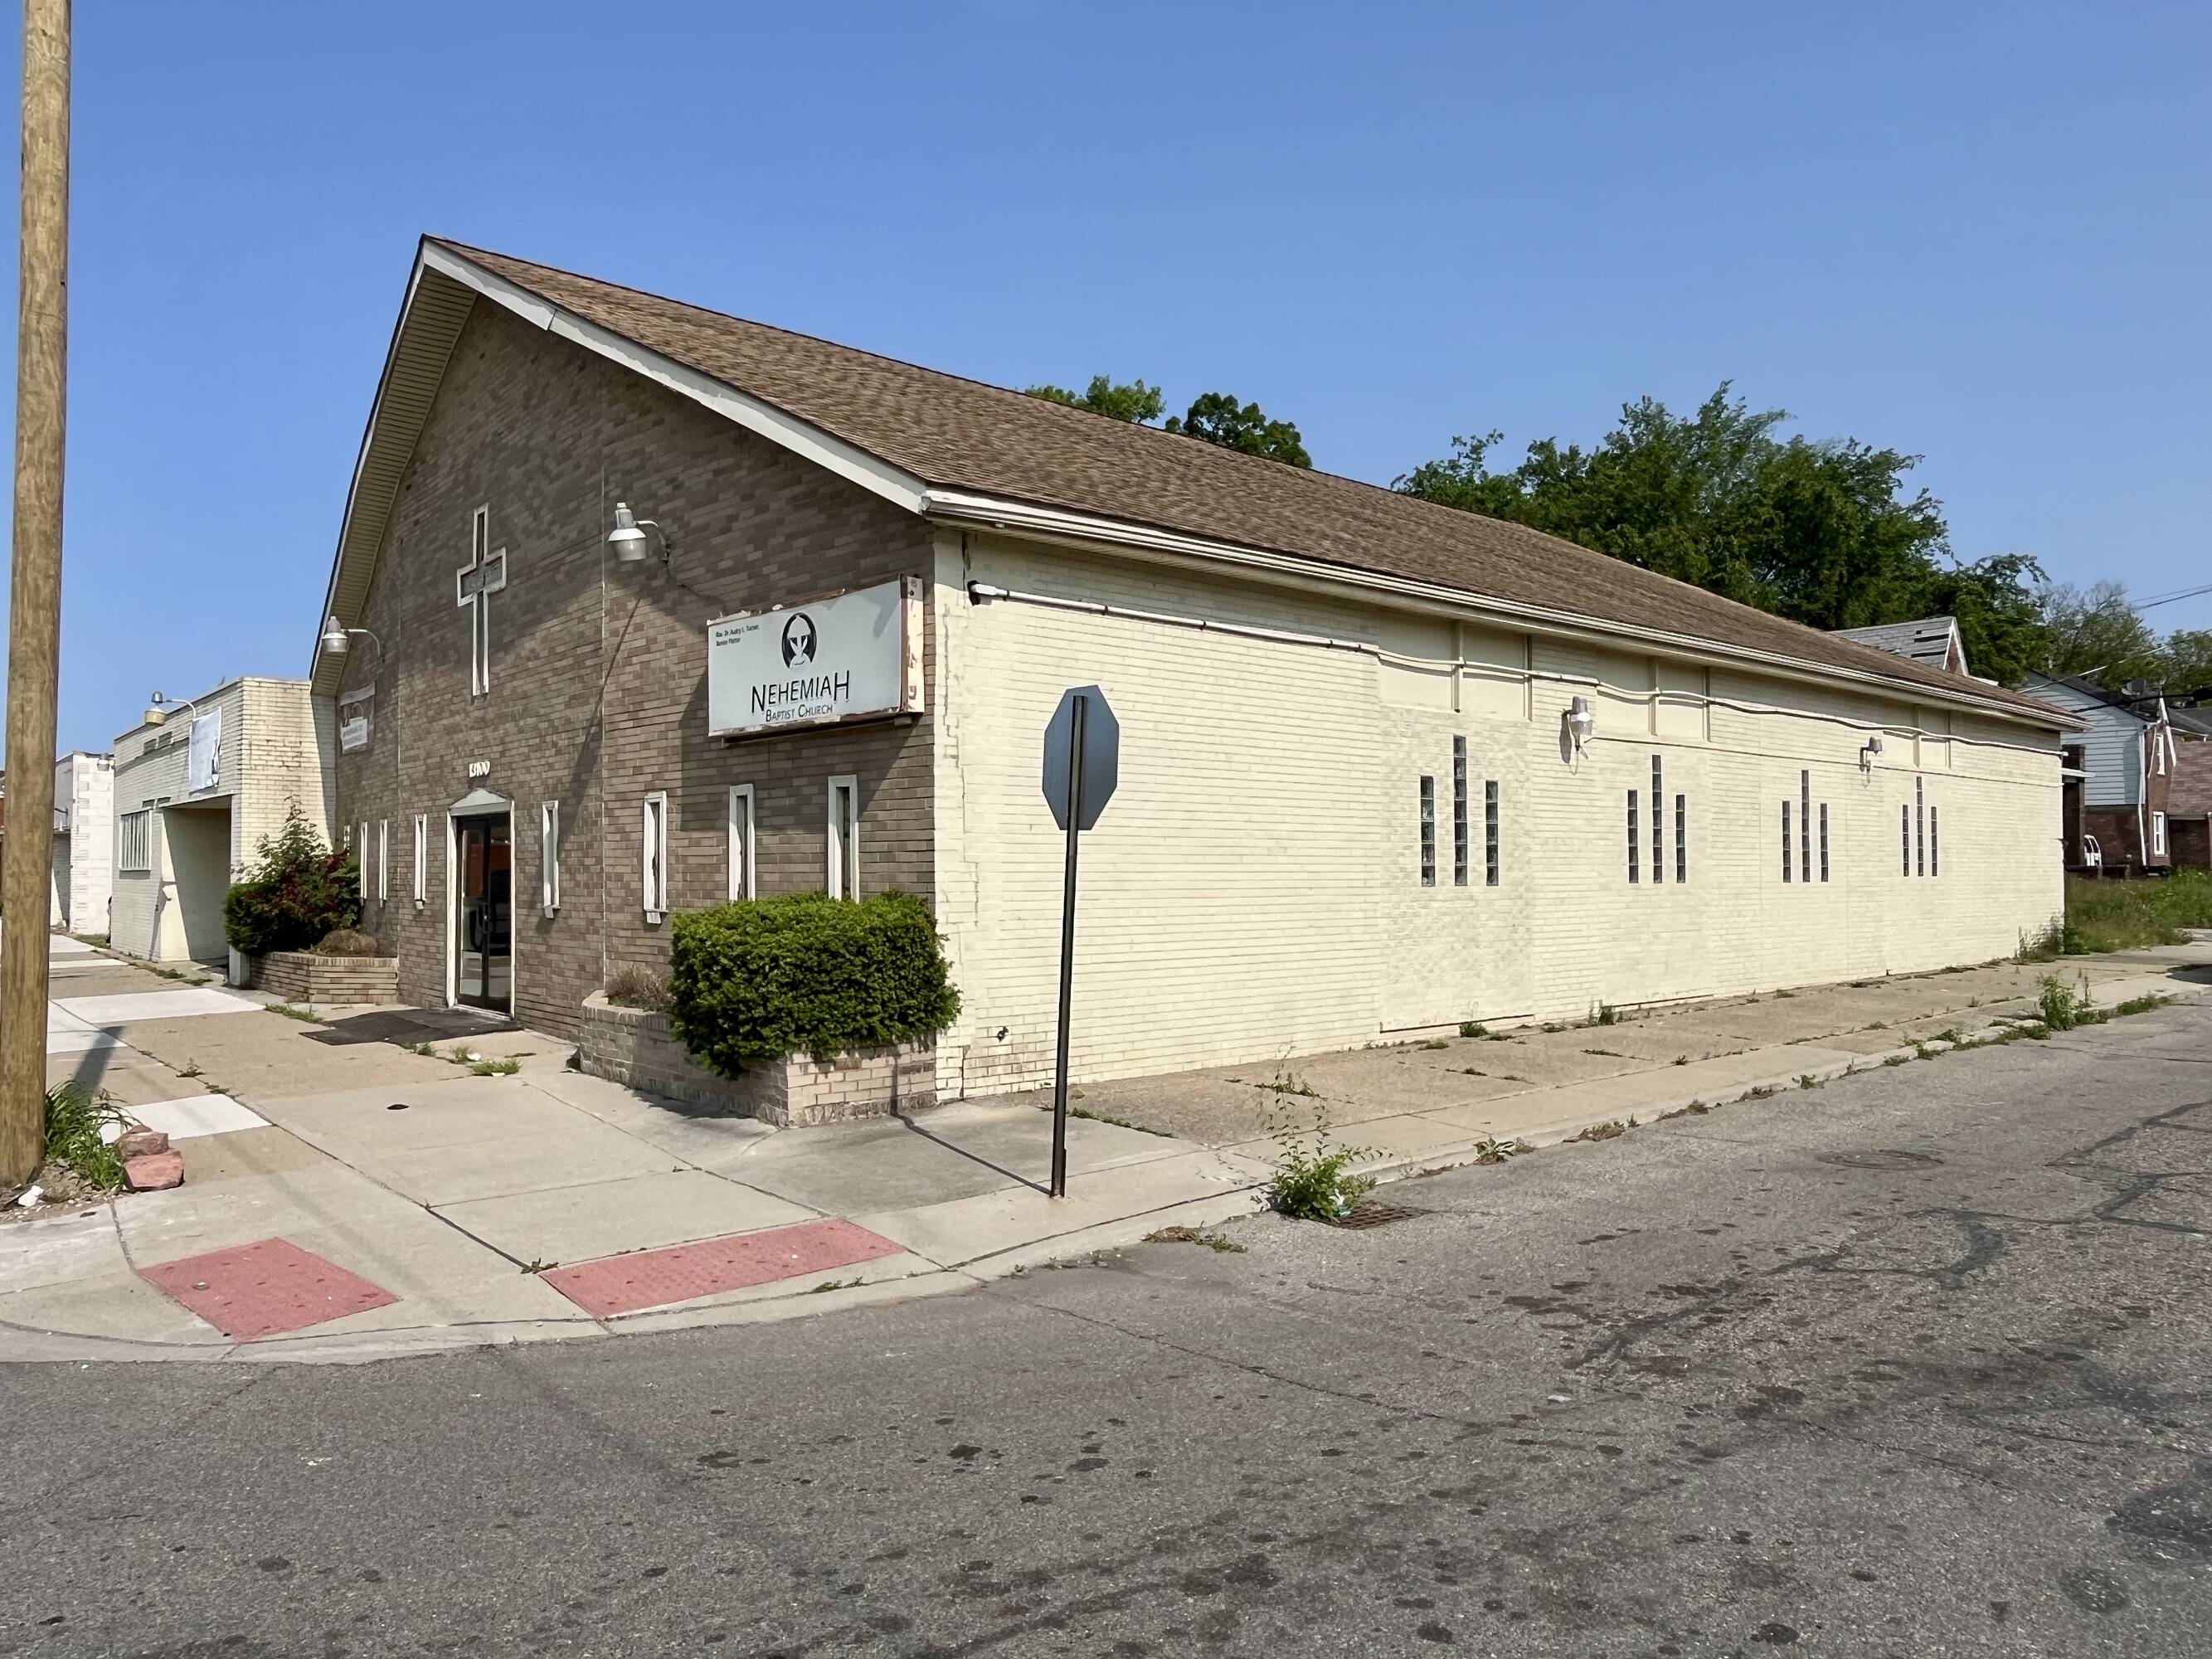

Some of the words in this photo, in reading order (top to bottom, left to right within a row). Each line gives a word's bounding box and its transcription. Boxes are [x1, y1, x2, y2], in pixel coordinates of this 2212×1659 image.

[751, 670, 849, 713] NEHEMIAH
[766, 708, 795, 722] BAPTIST
[798, 704, 833, 718] CHURCH
